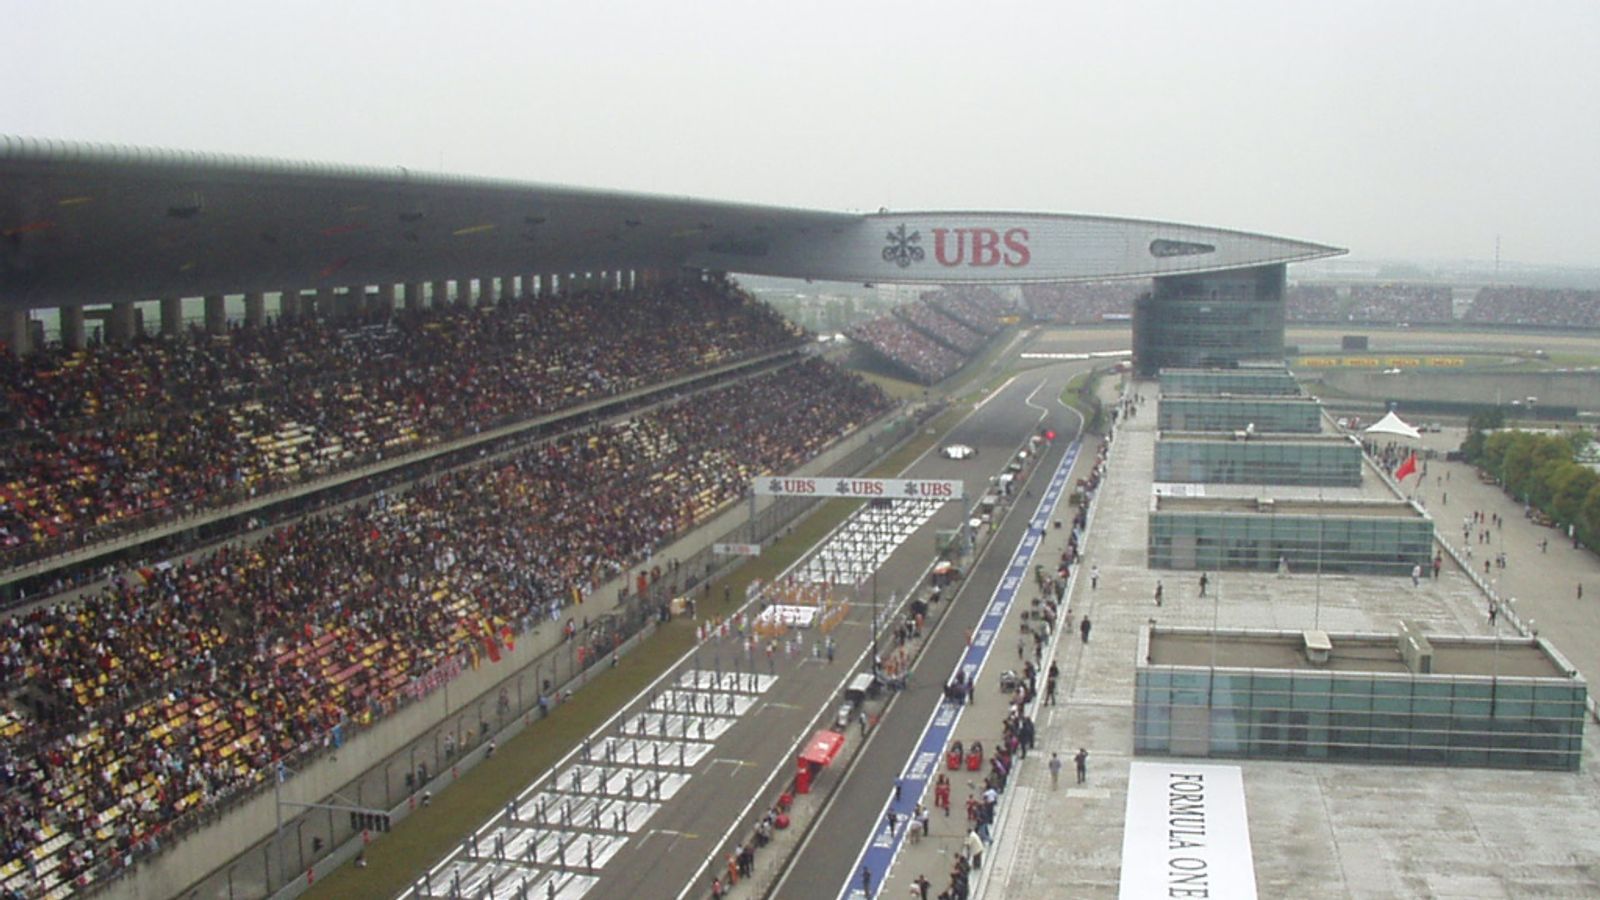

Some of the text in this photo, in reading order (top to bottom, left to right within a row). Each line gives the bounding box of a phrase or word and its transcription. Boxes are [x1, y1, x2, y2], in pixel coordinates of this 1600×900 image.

[933, 228, 1030, 266] UBS
[784, 479, 952, 496] UBS UBS UBS
[1168, 773, 1209, 898] FORMULA ONE
